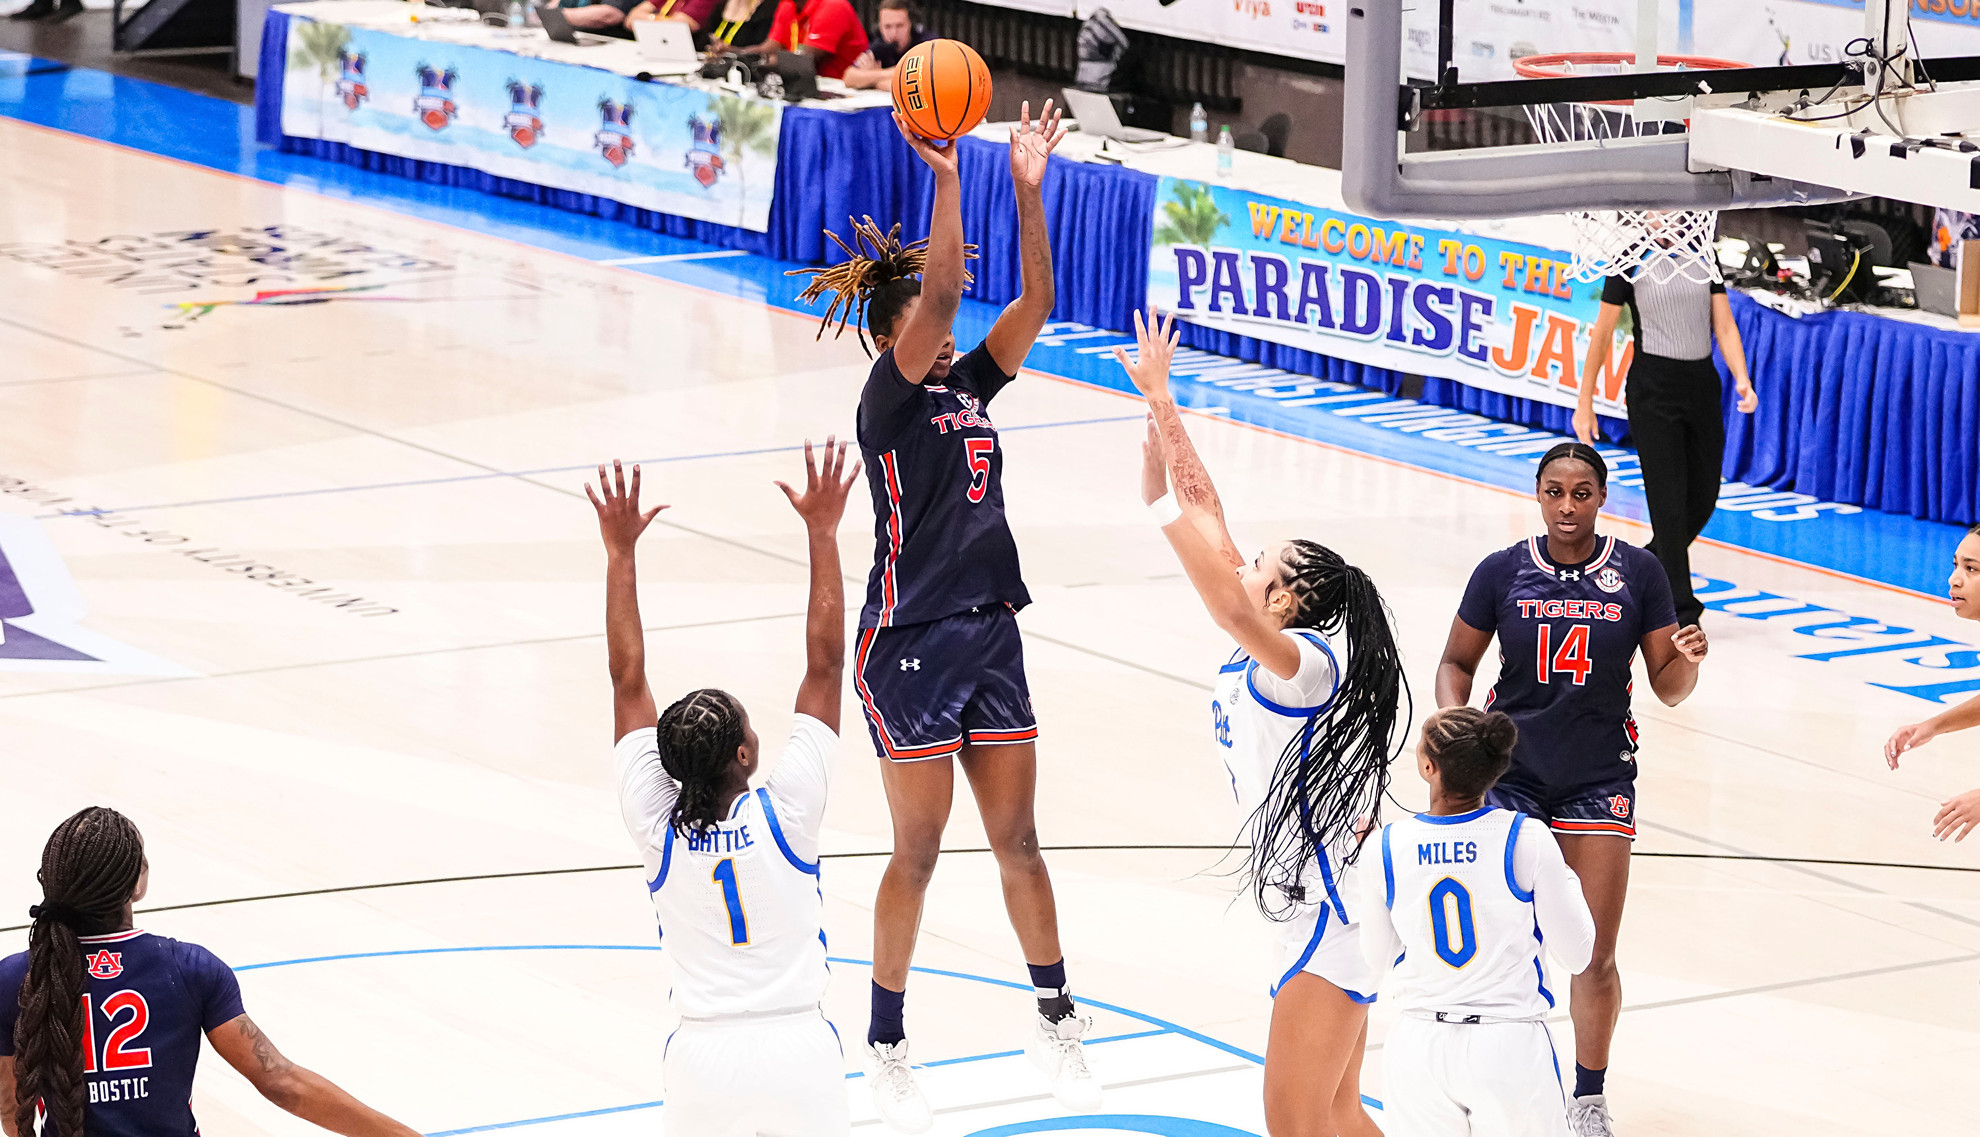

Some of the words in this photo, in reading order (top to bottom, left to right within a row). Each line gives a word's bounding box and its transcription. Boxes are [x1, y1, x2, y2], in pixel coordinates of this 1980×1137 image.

[905, 56, 924, 111] ELITE
[1248, 202, 1424, 271] WELCOME
[1439, 238, 1486, 282] TO
[1500, 251, 1572, 300] THE
[1174, 248, 1495, 362] PARADISE
[964, 437, 994, 503] 5
[1600, 569, 1620, 587] SEC
[1517, 600, 1623, 622] TIGERS
[1536, 624, 1592, 686] 14
[688, 825, 754, 852] BATTLE
[1418, 841, 1478, 865] MILES
[711, 857, 750, 946] 1
[1427, 875, 1480, 970] 0
[82, 989, 152, 1073] 12
[88, 1077, 149, 1103] BOSTIC
